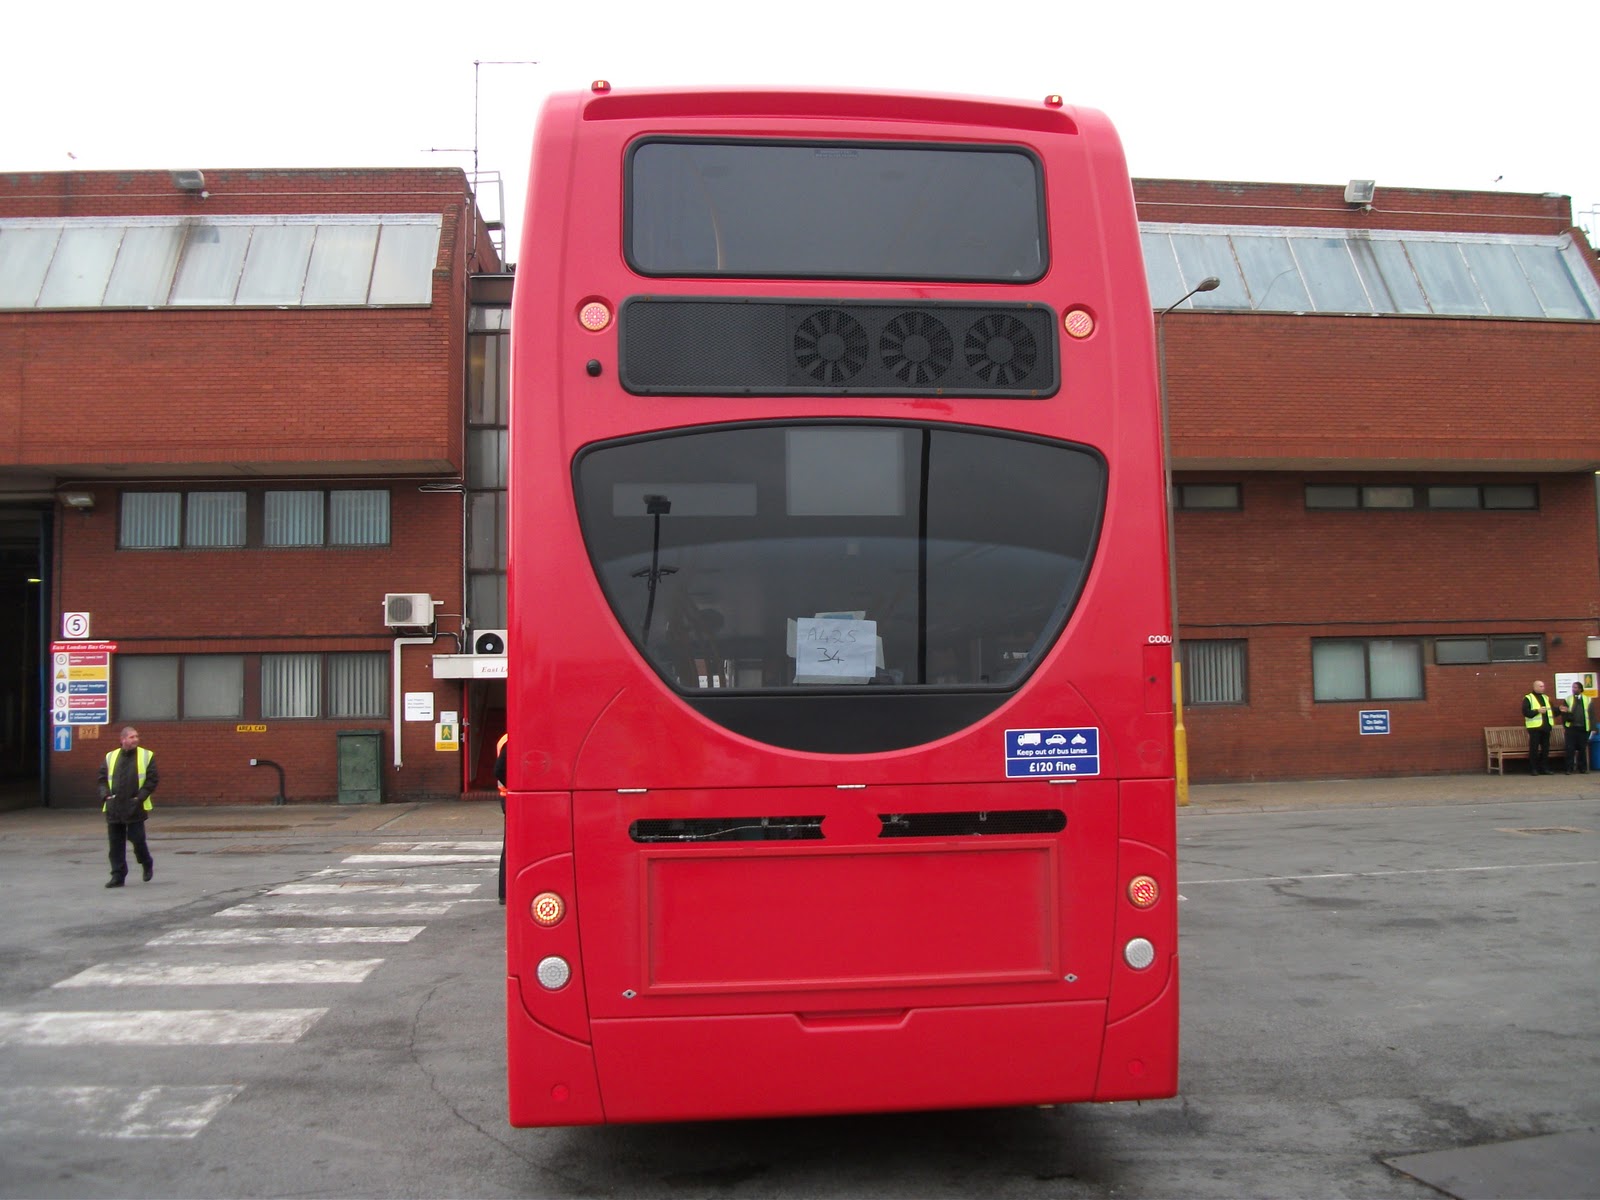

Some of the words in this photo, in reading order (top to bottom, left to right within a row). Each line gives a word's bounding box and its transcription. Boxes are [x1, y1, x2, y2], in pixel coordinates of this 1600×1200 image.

[72, 619, 81, 631] 5
[816, 647, 845, 664] 34
[1029, 761, 1053, 772] £120
[1055, 761, 1077, 771] fine
